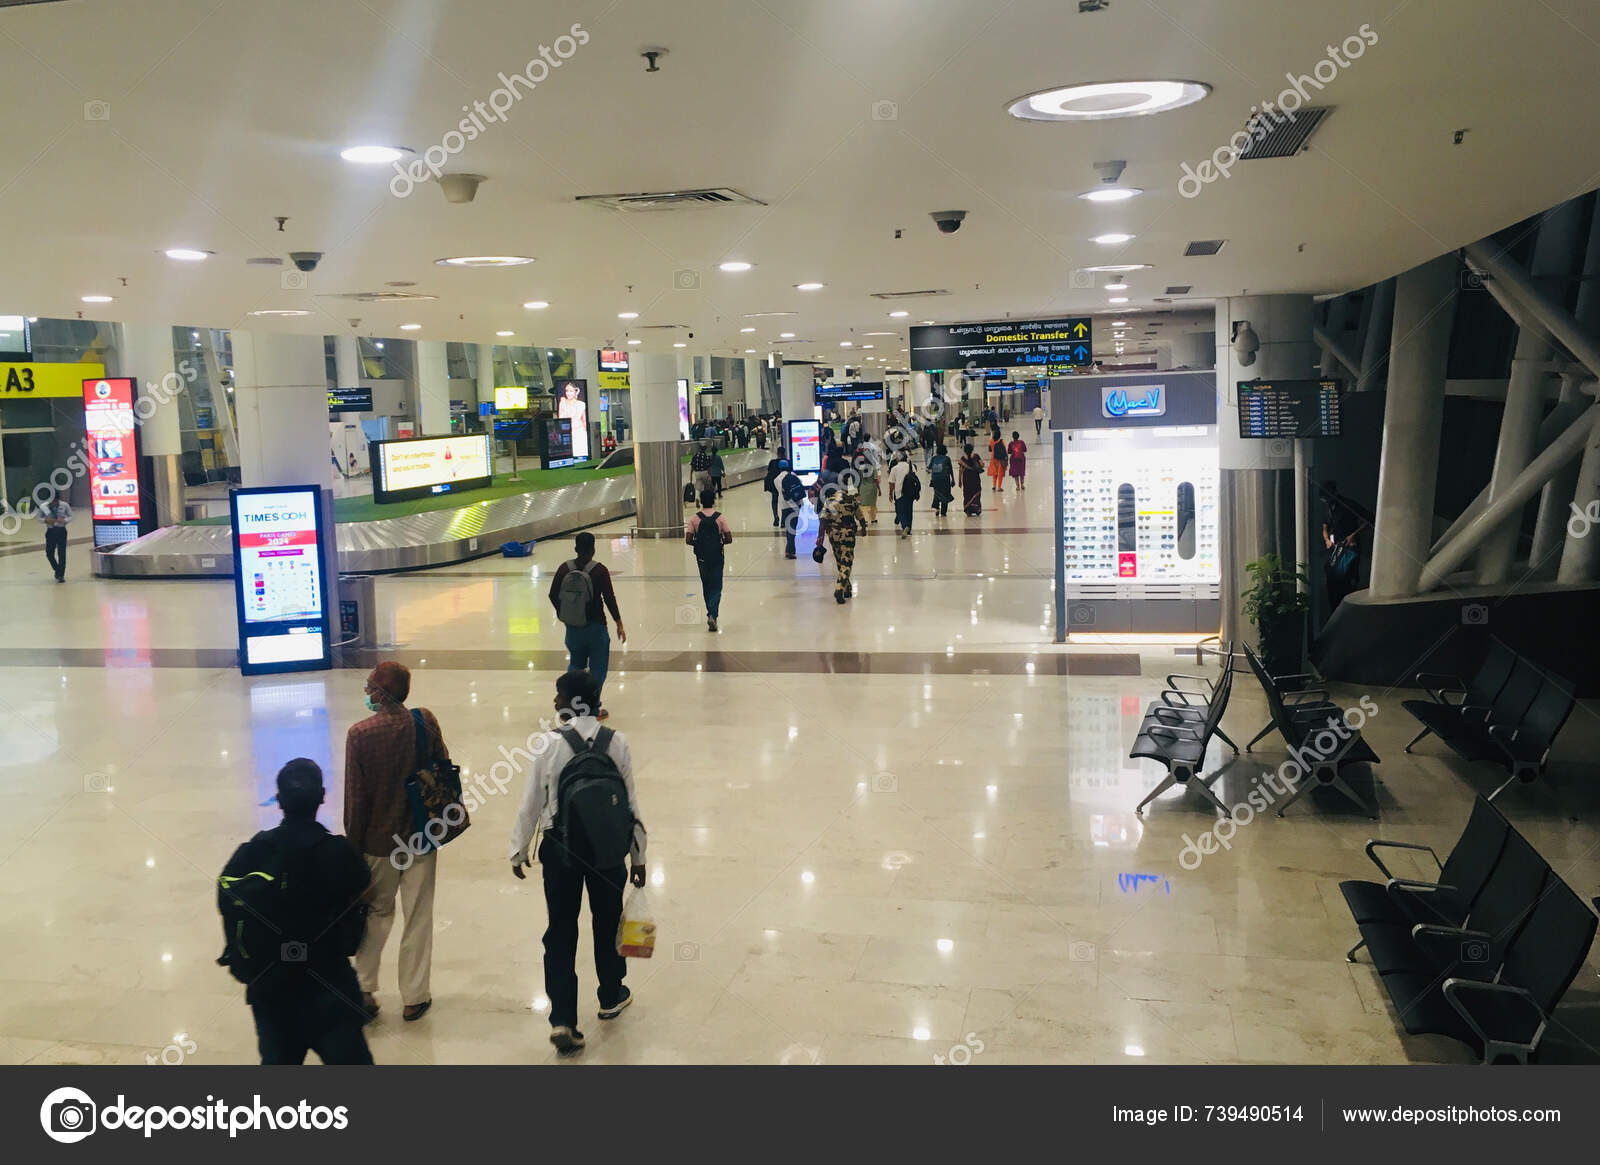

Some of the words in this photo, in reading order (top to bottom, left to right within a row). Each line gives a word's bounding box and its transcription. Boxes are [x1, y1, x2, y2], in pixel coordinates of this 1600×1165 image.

[986, 332, 1029, 343] Domestic
[1031, 330, 1069, 341] Transfer
[1025, 354, 1047, 364] Baby
[1050, 353, 1071, 362] Care
[6, 367, 34, 392] A3
[244, 513, 279, 522] TIMES
